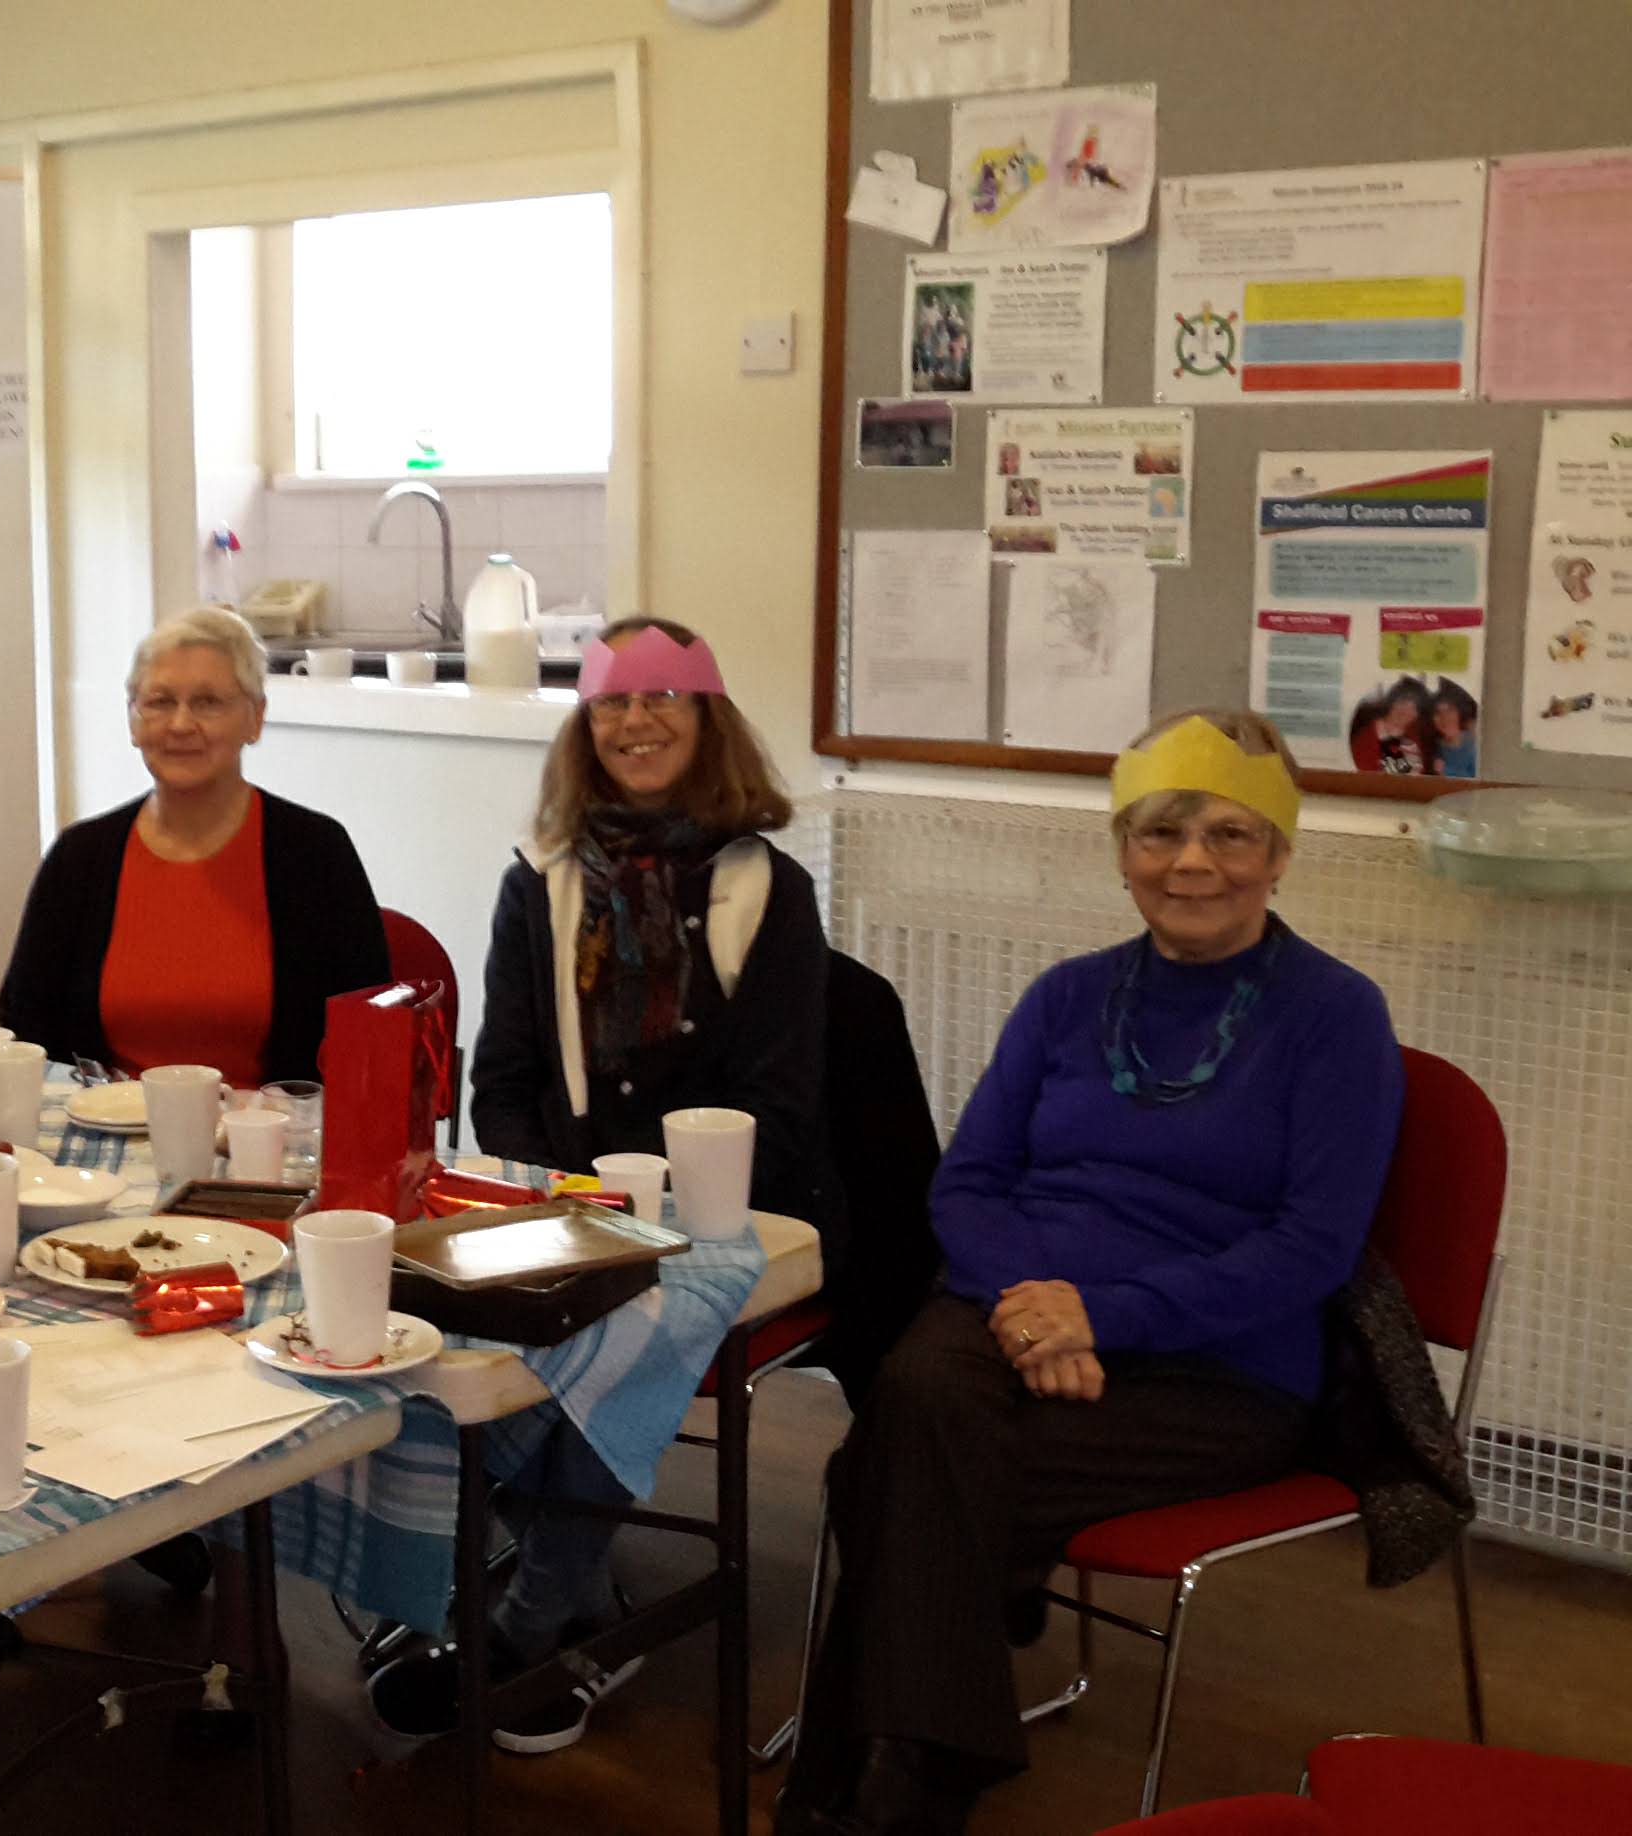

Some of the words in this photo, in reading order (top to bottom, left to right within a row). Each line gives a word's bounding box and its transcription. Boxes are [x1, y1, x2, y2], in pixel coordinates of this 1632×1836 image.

[1271, 503, 1348, 522] Sheffield
[1350, 503, 1409, 523] Carers
[1411, 504, 1473, 523] Centre
